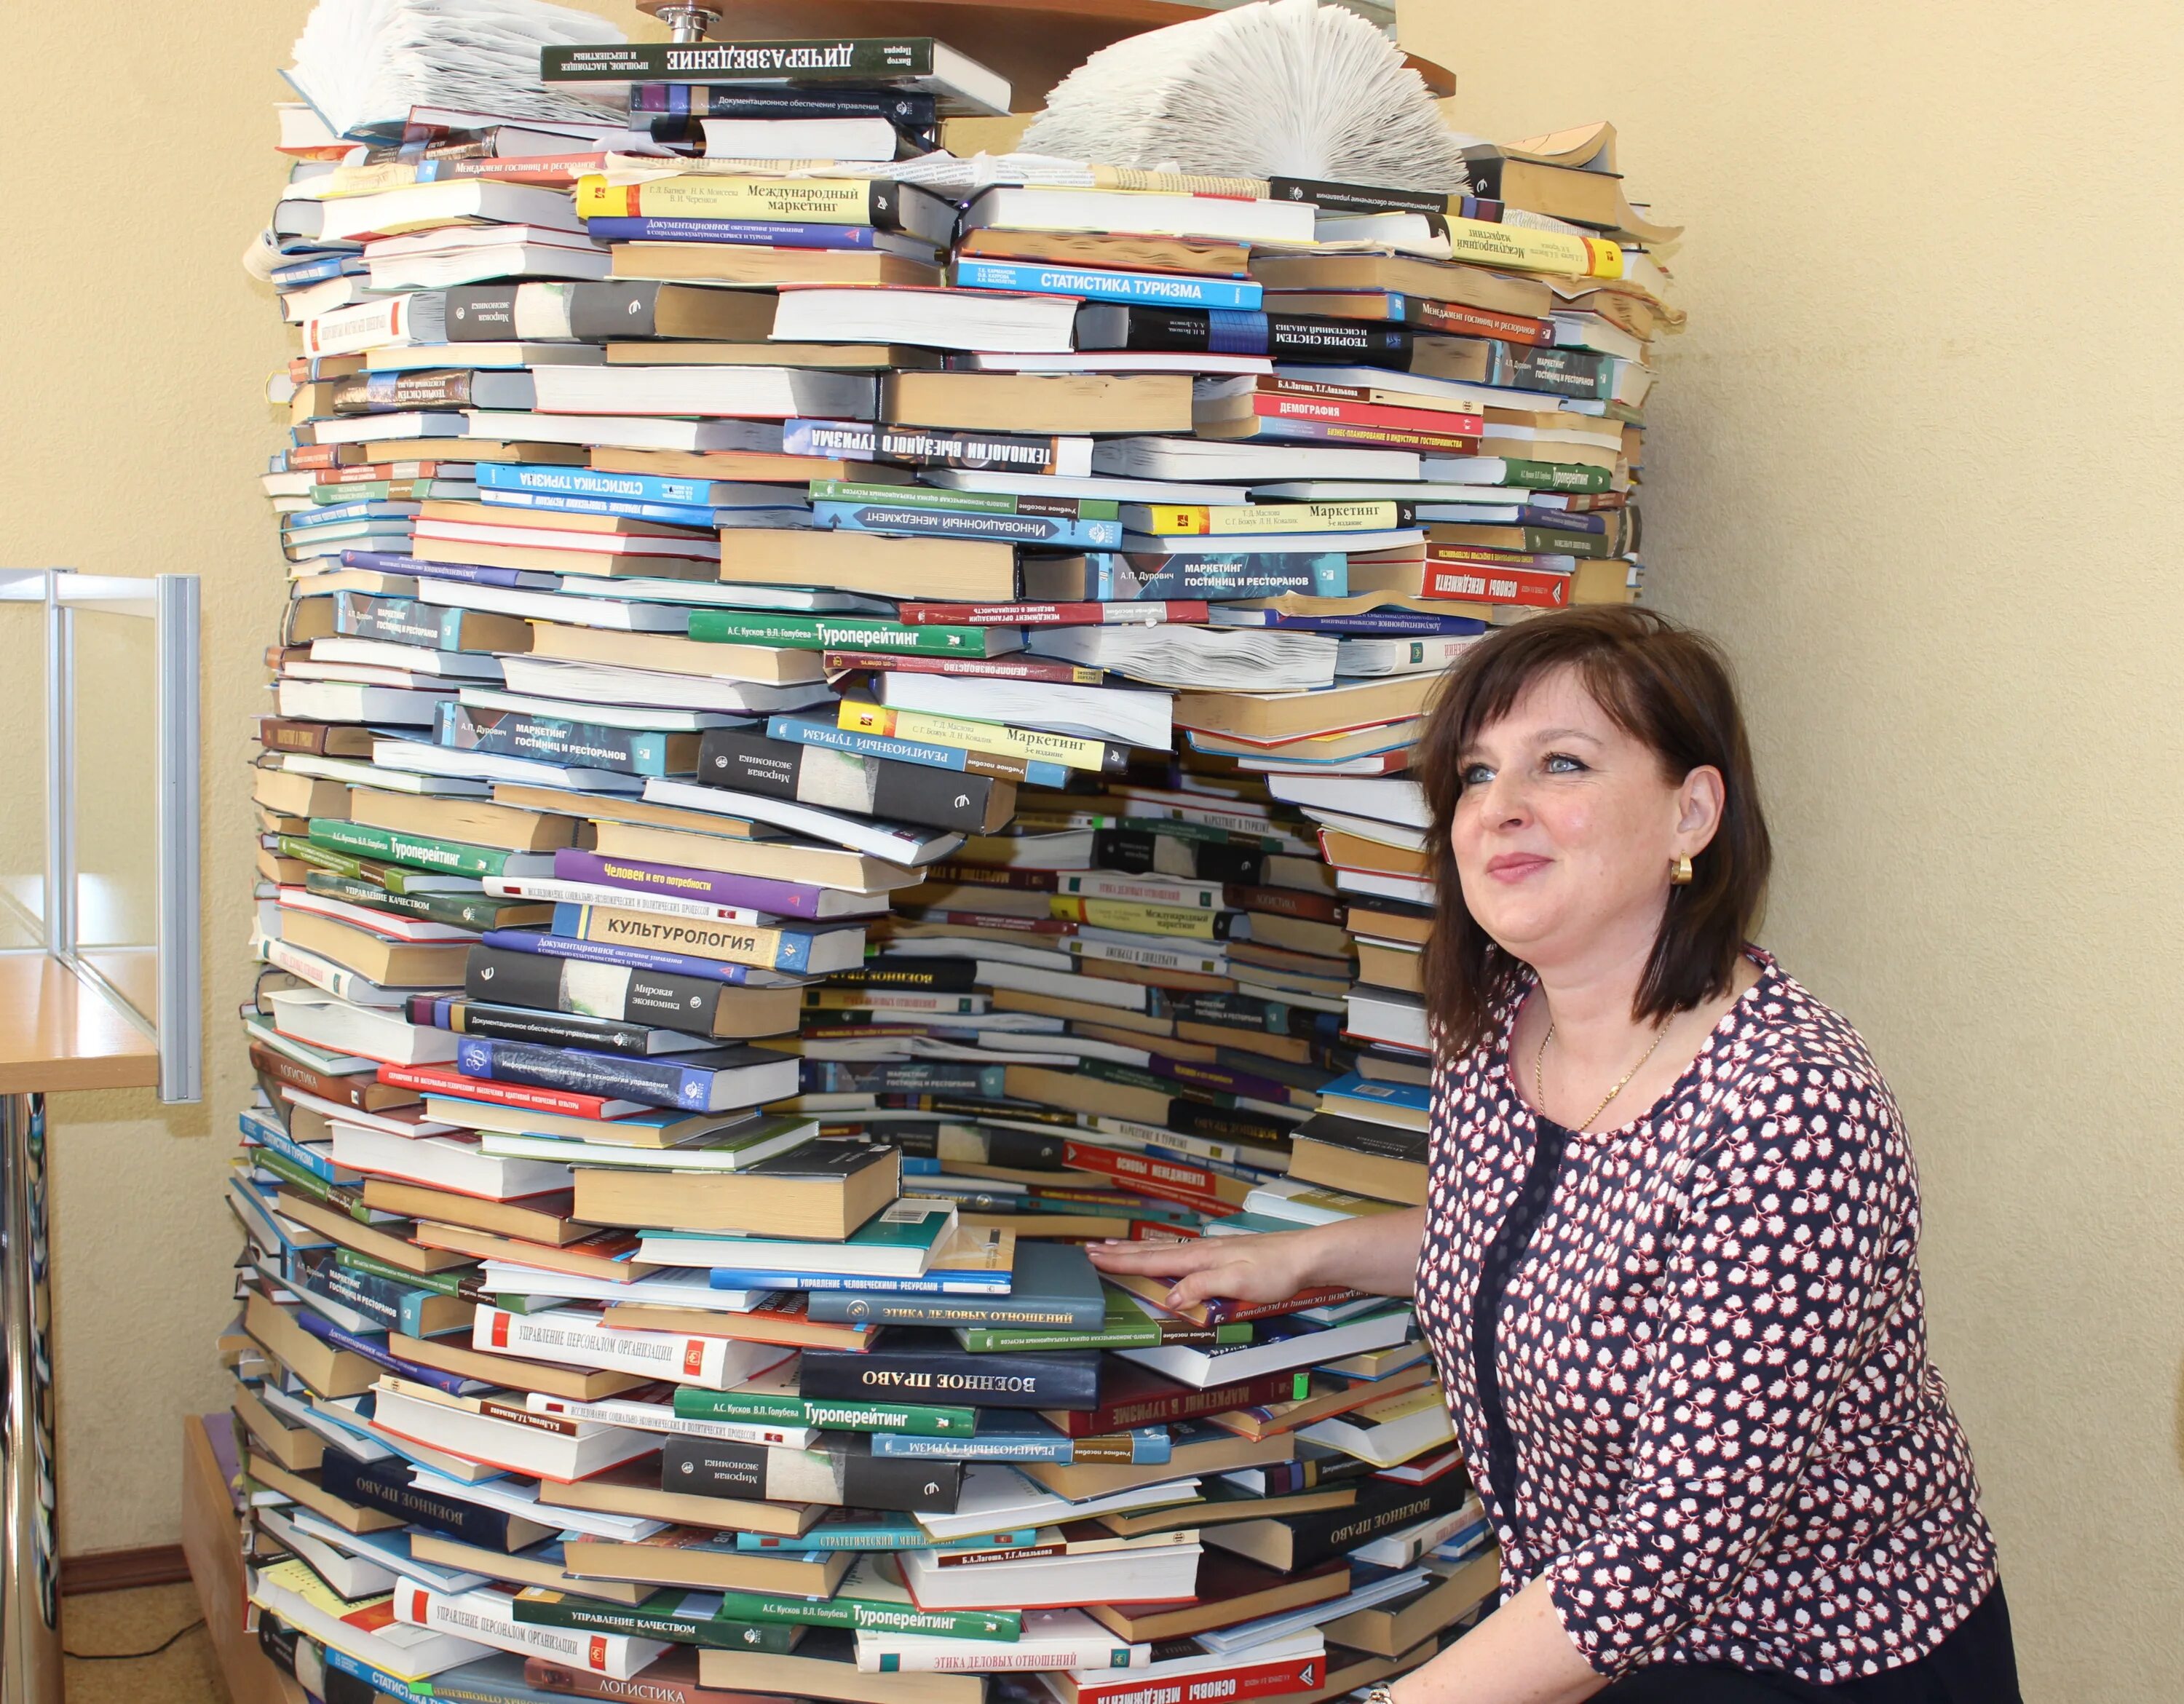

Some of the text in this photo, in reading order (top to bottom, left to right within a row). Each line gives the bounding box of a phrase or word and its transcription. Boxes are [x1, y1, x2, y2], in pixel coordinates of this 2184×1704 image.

[574, 52, 628, 60] ПЕРСПЕКТИВЫ
[667, 44, 854, 71] ДИЧЕРАЗВЕДЕНИЕ
[884, 47, 912, 66] Виктор Перерва
[561, 62, 649, 71] ПРОШЛОЕ, НАСТОЯЩЕЕ
[719, 96, 879, 112] Документационное обеспечение управления
[747, 185, 858, 202] Международный
[767, 199, 837, 214] маркетинг
[1469, 229, 1511, 243] маркетинг
[1457, 238, 1525, 260] Международный
[1040, 272, 1202, 299] СТАТИСТИКА ТУРИЗМА
[1276, 323, 1304, 333] АНАЛИЗ
[1307, 325, 1360, 336] СИСТЕМНЫЙ
[1276, 333, 1367, 348] ТЕОРИЯ СИСТЕМ
[1537, 357, 1565, 370] МАРКЕТИНГ
[1564, 374, 1594, 387] РЕСТОРАНОВ
[1279, 401, 1340, 418] ДЕМОГРАФИЯ
[812, 429, 1051, 465] ТЕХНОЛОГИИ ВЫЕЗДНОГО ТУРИЗМА
[1327, 427, 1385, 442] БИЗНЕС-ПЛАНИРОВАНИЕ
[1391, 434, 1419, 445] ИНДУСТРИИ
[1420, 436, 1463, 449] ГОСТЕПРИИМСТВА
[521, 472, 571, 490] ТУРИЗМА
[574, 477, 644, 496] СТАТИСТИКА
[1552, 467, 1588, 488] Туроперейтинг
[1310, 505, 1380, 519] Маркетинг
[1120, 571, 1175, 582] А.П. Дурович
[1184, 563, 1243, 574] МАРКЕТИНГ
[1184, 576, 1310, 588] ГОСТИНИЦ И РЕСТОРАНОВ
[1435, 574, 1486, 595] МЕНЕДЖМЕНТА
[1488, 579, 1518, 598] ОСНОВЫ
[969, 613, 1060, 622] МЕНЕДЖМЕНТ ОРГАНИЗАЦИИ
[728, 627, 812, 641] А.С. Кусков В.Л. Голубева
[815, 623, 919, 648] Туроперейтинг
[943, 663, 1028, 677] ДЕЛОПРОИЗВОДСТВО
[461, 723, 507, 737] А.П. Дурович
[515, 724, 567, 740] МАРКЕТИНГ
[515, 737, 627, 761] ГОСТИНИЦ И РЕСТОРАНОВ
[803, 728, 949, 763] РЕЛИГИОЗНЫЙ ТУРИЗМ
[1006, 728, 1087, 753] Маркетинг
[738, 753, 793, 770] экономика
[967, 758, 1024, 775] Учебное пособие
[747, 768, 791, 784] Мировая
[389, 836, 461, 867] Туроперейтинг
[604, 863, 712, 892] Человек и его потребности
[345, 886, 430, 911] УПРАВЛЕНИЕ КАЧЕСТВОМ
[1145, 908, 1208, 923] Международный
[607, 918, 756, 952] КУЛЬТУРОЛОГИЯ
[633, 984, 673, 997] Мировая
[631, 996, 680, 1010] экономика
[472, 1016, 601, 1042] Документационное обеспечение управления
[280, 1063, 318, 1087] ЛОГИСТИКА
[502, 1061, 558, 1076] Информационные
[559, 1069, 585, 1079] системы
[593, 1073, 629, 1085] технологии
[630, 1077, 669, 1090] управления
[329, 1268, 361, 1288] МАРКЕТИНГ
[800, 1277, 938, 1292] УПРАВЛЕНИЕ ЧЕЛОВЕЧЕСКИМИ РЕСУРСАМИ
[329, 1282, 355, 1303] ГОСТИНИЦ
[362, 1294, 397, 1318] РЕСТОРАНОВ
[882, 1307, 1074, 1325] ЭТИКА ДЕЛОВЫХ ОТНОШЕНИЙ
[518, 1325, 673, 1363] УПРАВЛЕНИЕ ПЕРСОНАЛОМ ОРГАНИЗАЦИИ
[1190, 1331, 1216, 1339] Учебное
[861, 1370, 1037, 1393] ВОЕННОЕ ПРАВО
[713, 1403, 799, 1418] А.С. Кусков В.Л. Голубева
[804, 1402, 909, 1427] Туроперейтинг
[1113, 1386, 1250, 1425] МАРКЕТИНГ В ТУРИЗМЕ
[909, 1442, 1056, 1457] РЕЛИГИОЗНЫЙ ТУРИЗМ
[703, 1459, 759, 1471] экономика
[713, 1472, 759, 1484] Мировая
[356, 1476, 464, 1526] ВОЕННОЕ ПРАВО
[1373, 1497, 1431, 1529] ВОЕННОЕ
[1331, 1518, 1372, 1544] ПРАВО
[820, 1534, 893, 1548] СТРАТЕГИЧЕСКИЙ
[762, 1604, 848, 1619] А.С. Кусков В.Л. Голубева
[852, 1604, 957, 1630] Туроперейтинг
[437, 1605, 578, 1656] УПРАВЛЕНИЕ ПЕРСОНАЛОМ ОРГАНИЗАЦИИ
[571, 1611, 696, 1635] УПРАВЛЕНИЕ КАЧЕСТВОМ
[933, 1652, 1077, 1670] ЭТИКА ДЕЛОВЫХ ОТНОШЕНИЙ
[599, 1679, 686, 1704] ЛОГИСТИКА
[1188, 1679, 1236, 1701] ОСНОВЫ
